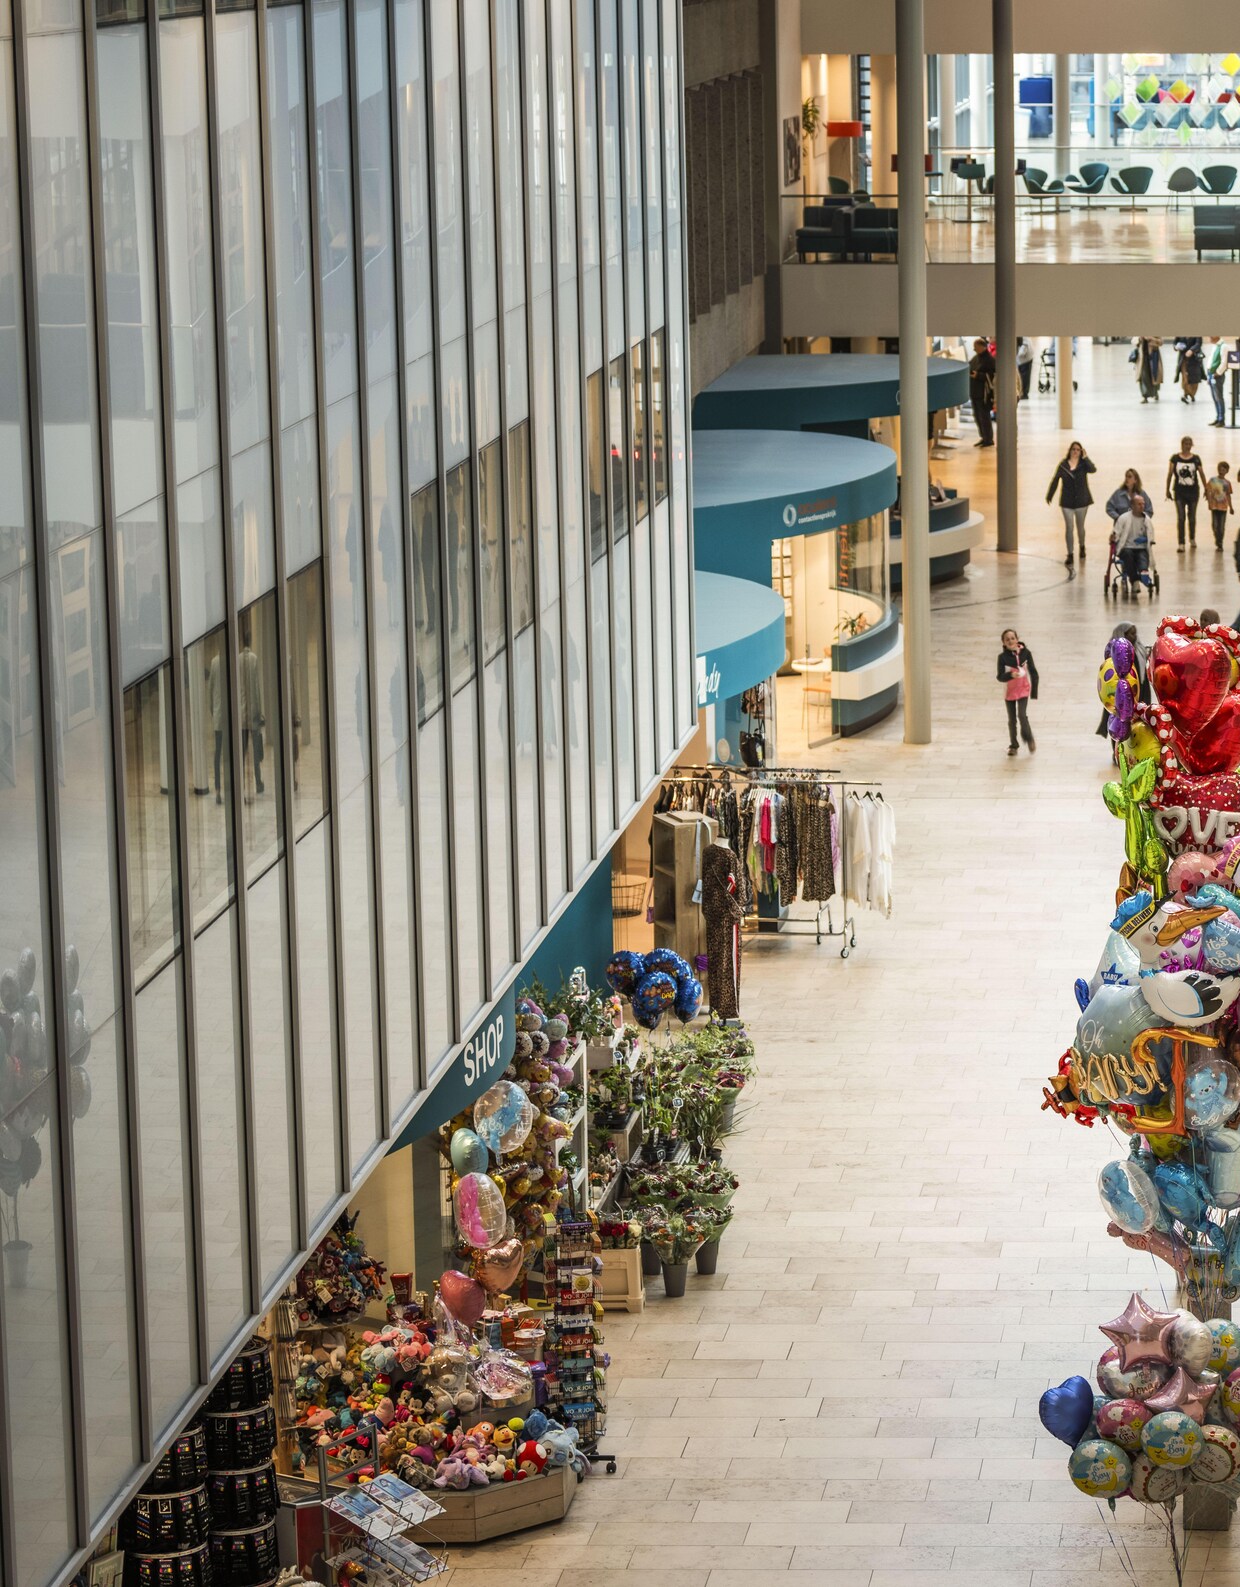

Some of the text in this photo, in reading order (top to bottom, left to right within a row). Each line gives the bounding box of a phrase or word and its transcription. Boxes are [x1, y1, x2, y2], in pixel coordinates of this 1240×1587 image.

[1208, 954, 1240, 969] Boy
[463, 1014, 504, 1087] SHOP
[1081, 1019, 1105, 1053] Oh
